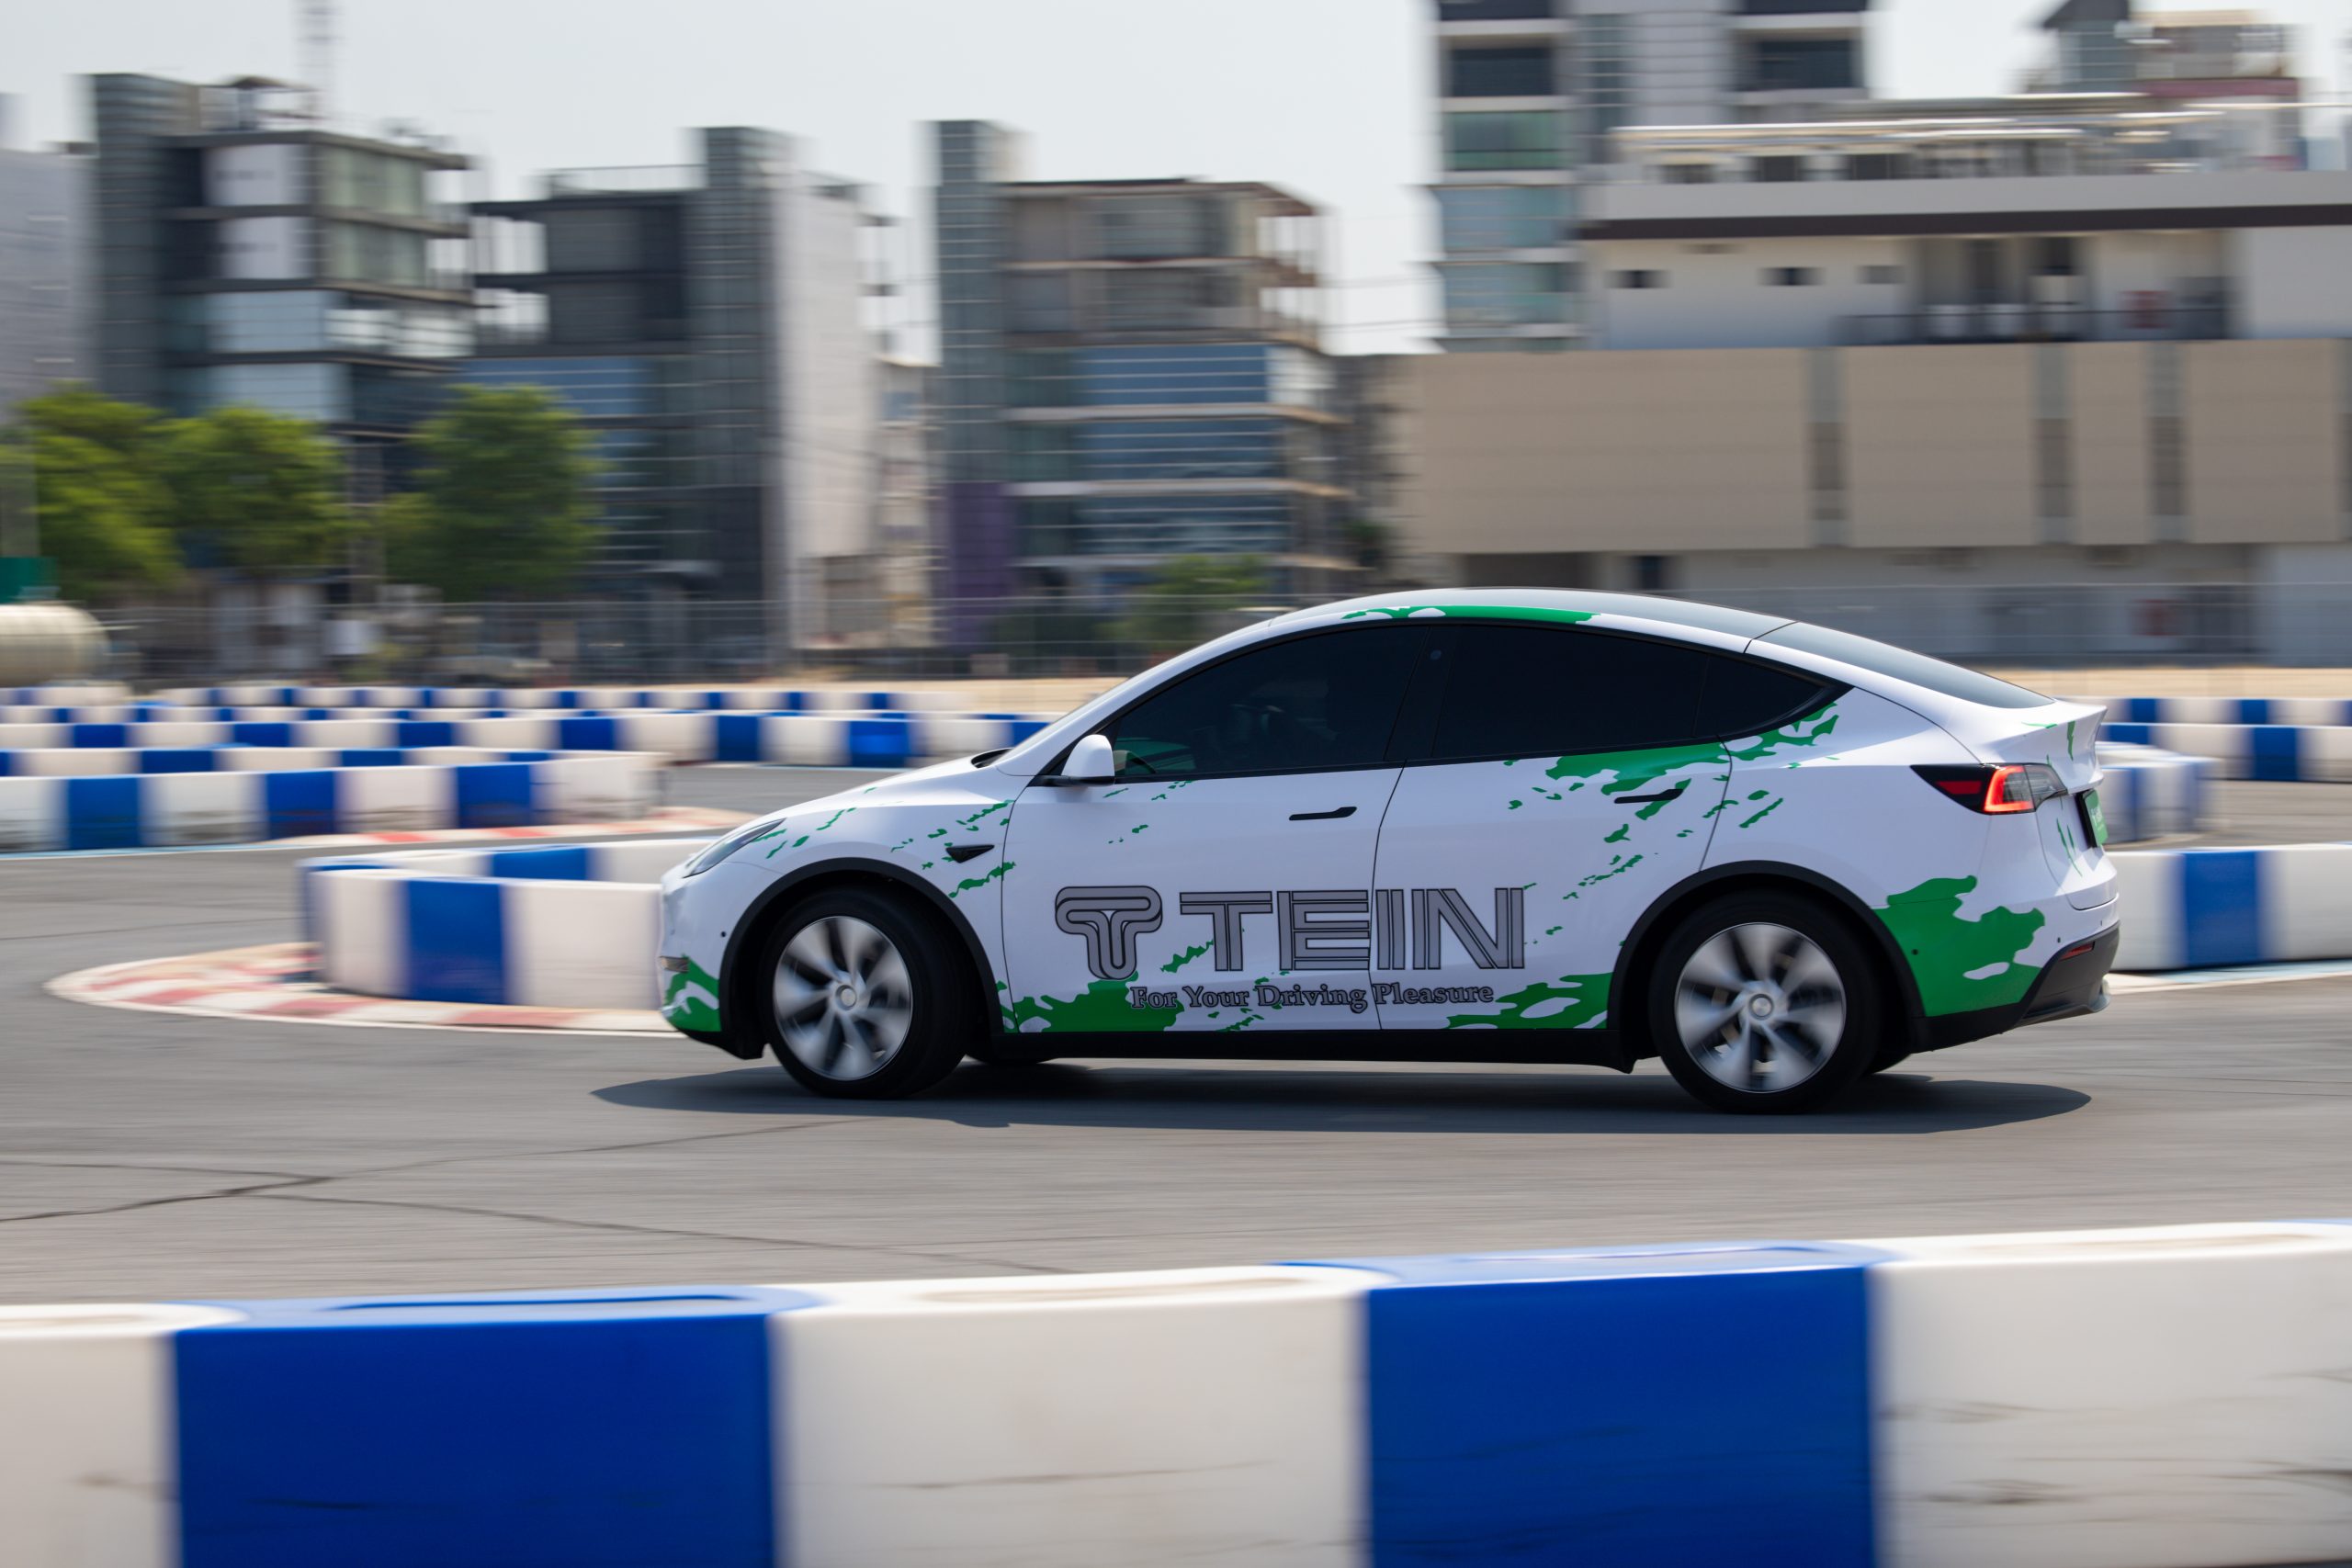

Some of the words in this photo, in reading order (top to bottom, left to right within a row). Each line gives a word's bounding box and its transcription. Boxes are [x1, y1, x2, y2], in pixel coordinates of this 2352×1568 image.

[1180, 887, 1525, 971] TEIN
[1130, 987, 1177, 1009] For
[1182, 986, 1250, 1008] Your
[1255, 984, 1368, 1013] Driving
[1372, 982, 1494, 1005] Pleasure
